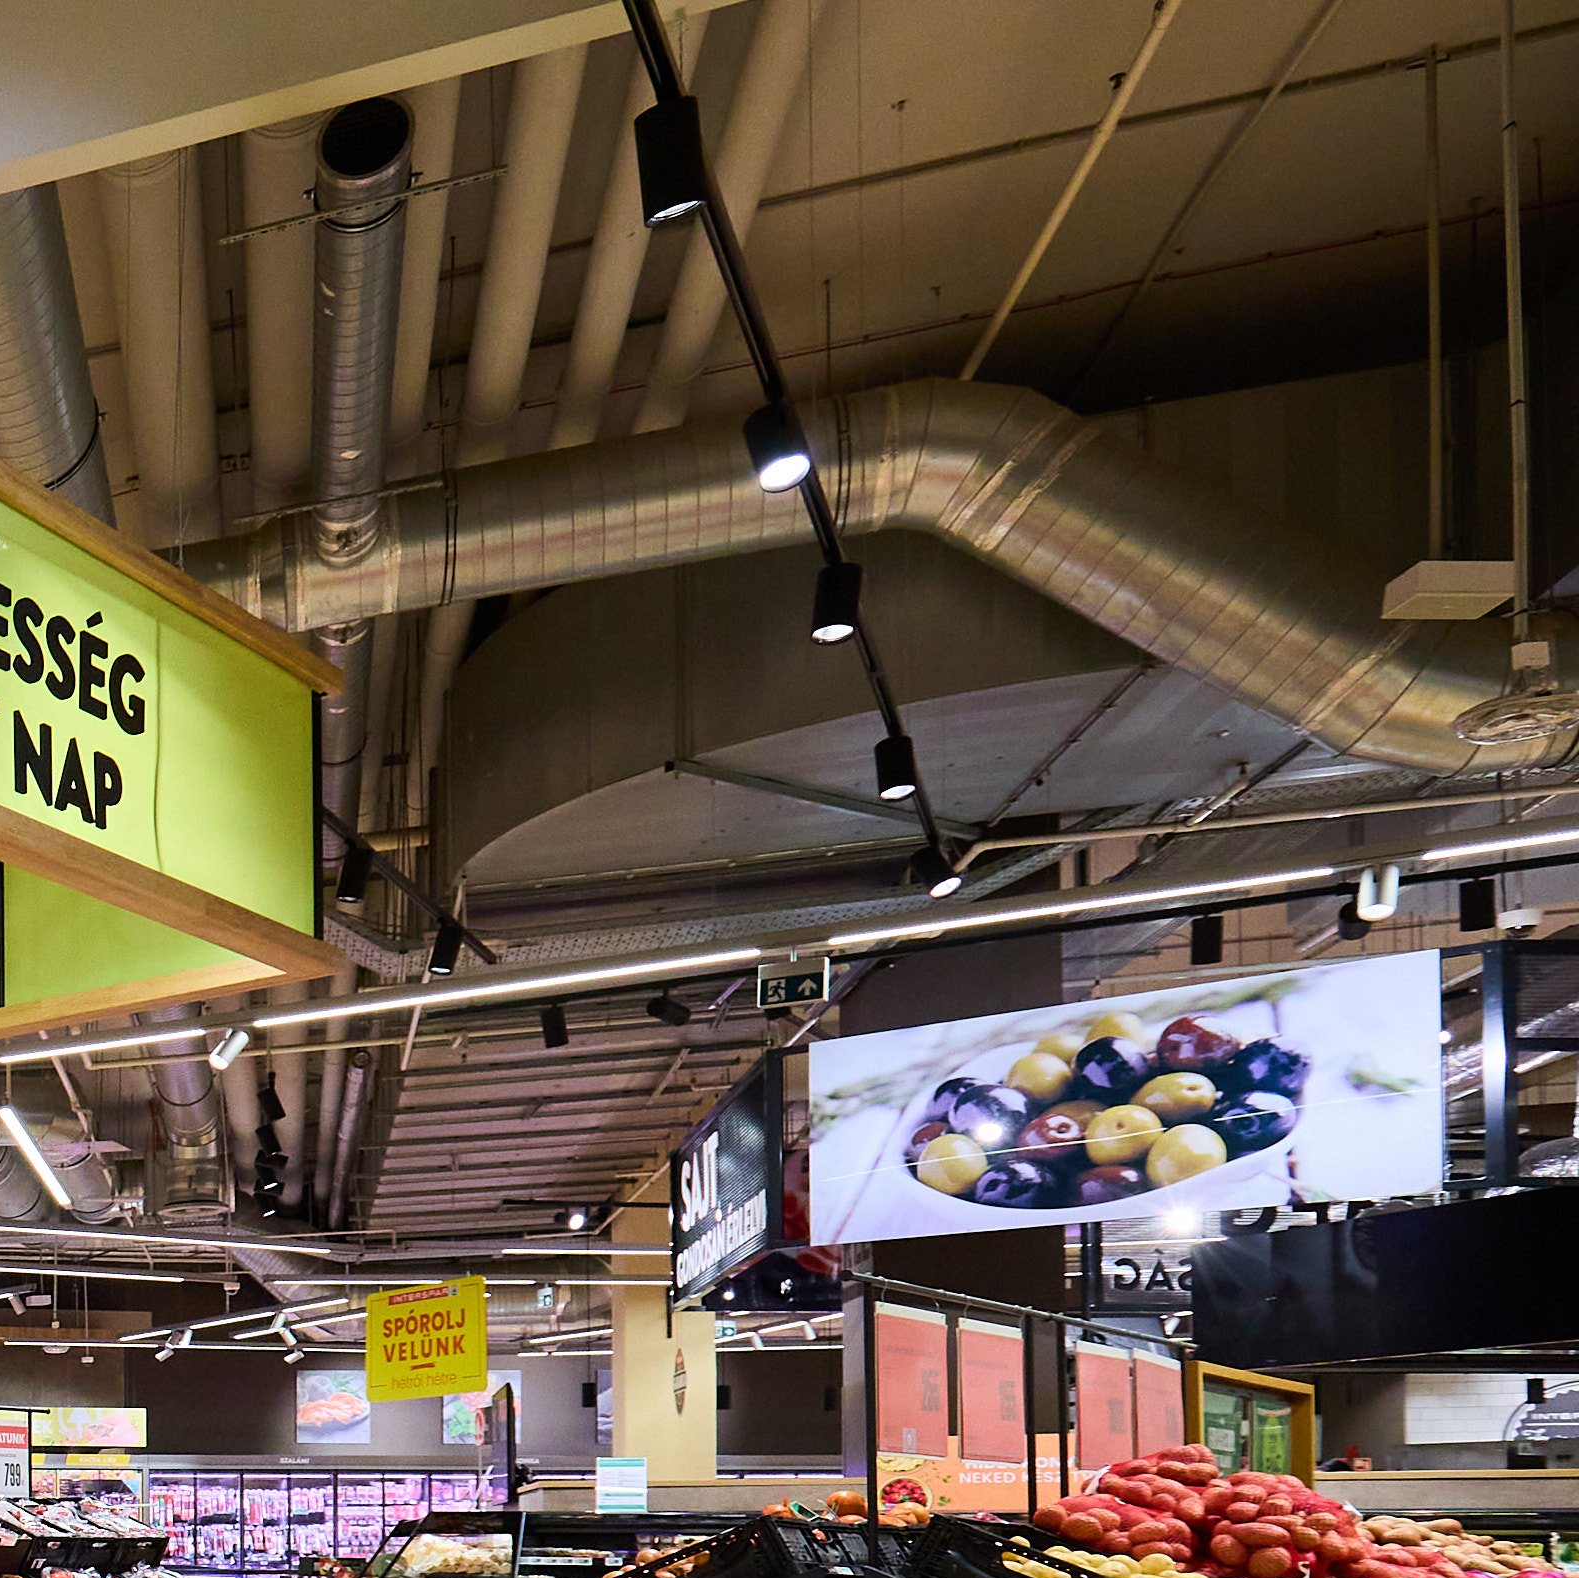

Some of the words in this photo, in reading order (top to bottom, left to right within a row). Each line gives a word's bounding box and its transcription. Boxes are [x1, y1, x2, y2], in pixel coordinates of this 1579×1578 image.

[14, 710, 122, 830] NAP
[676, 1221, 726, 1288] GONDOSAN
[392, 1287, 449, 1304] INTERSPAR
[383, 1308, 465, 1338] SPÓROLJ
[383, 1334, 465, 1362] VELÜNK
[4, 1463, 21, 1487] 799
[959, 1471, 1017, 1485] NEKED
